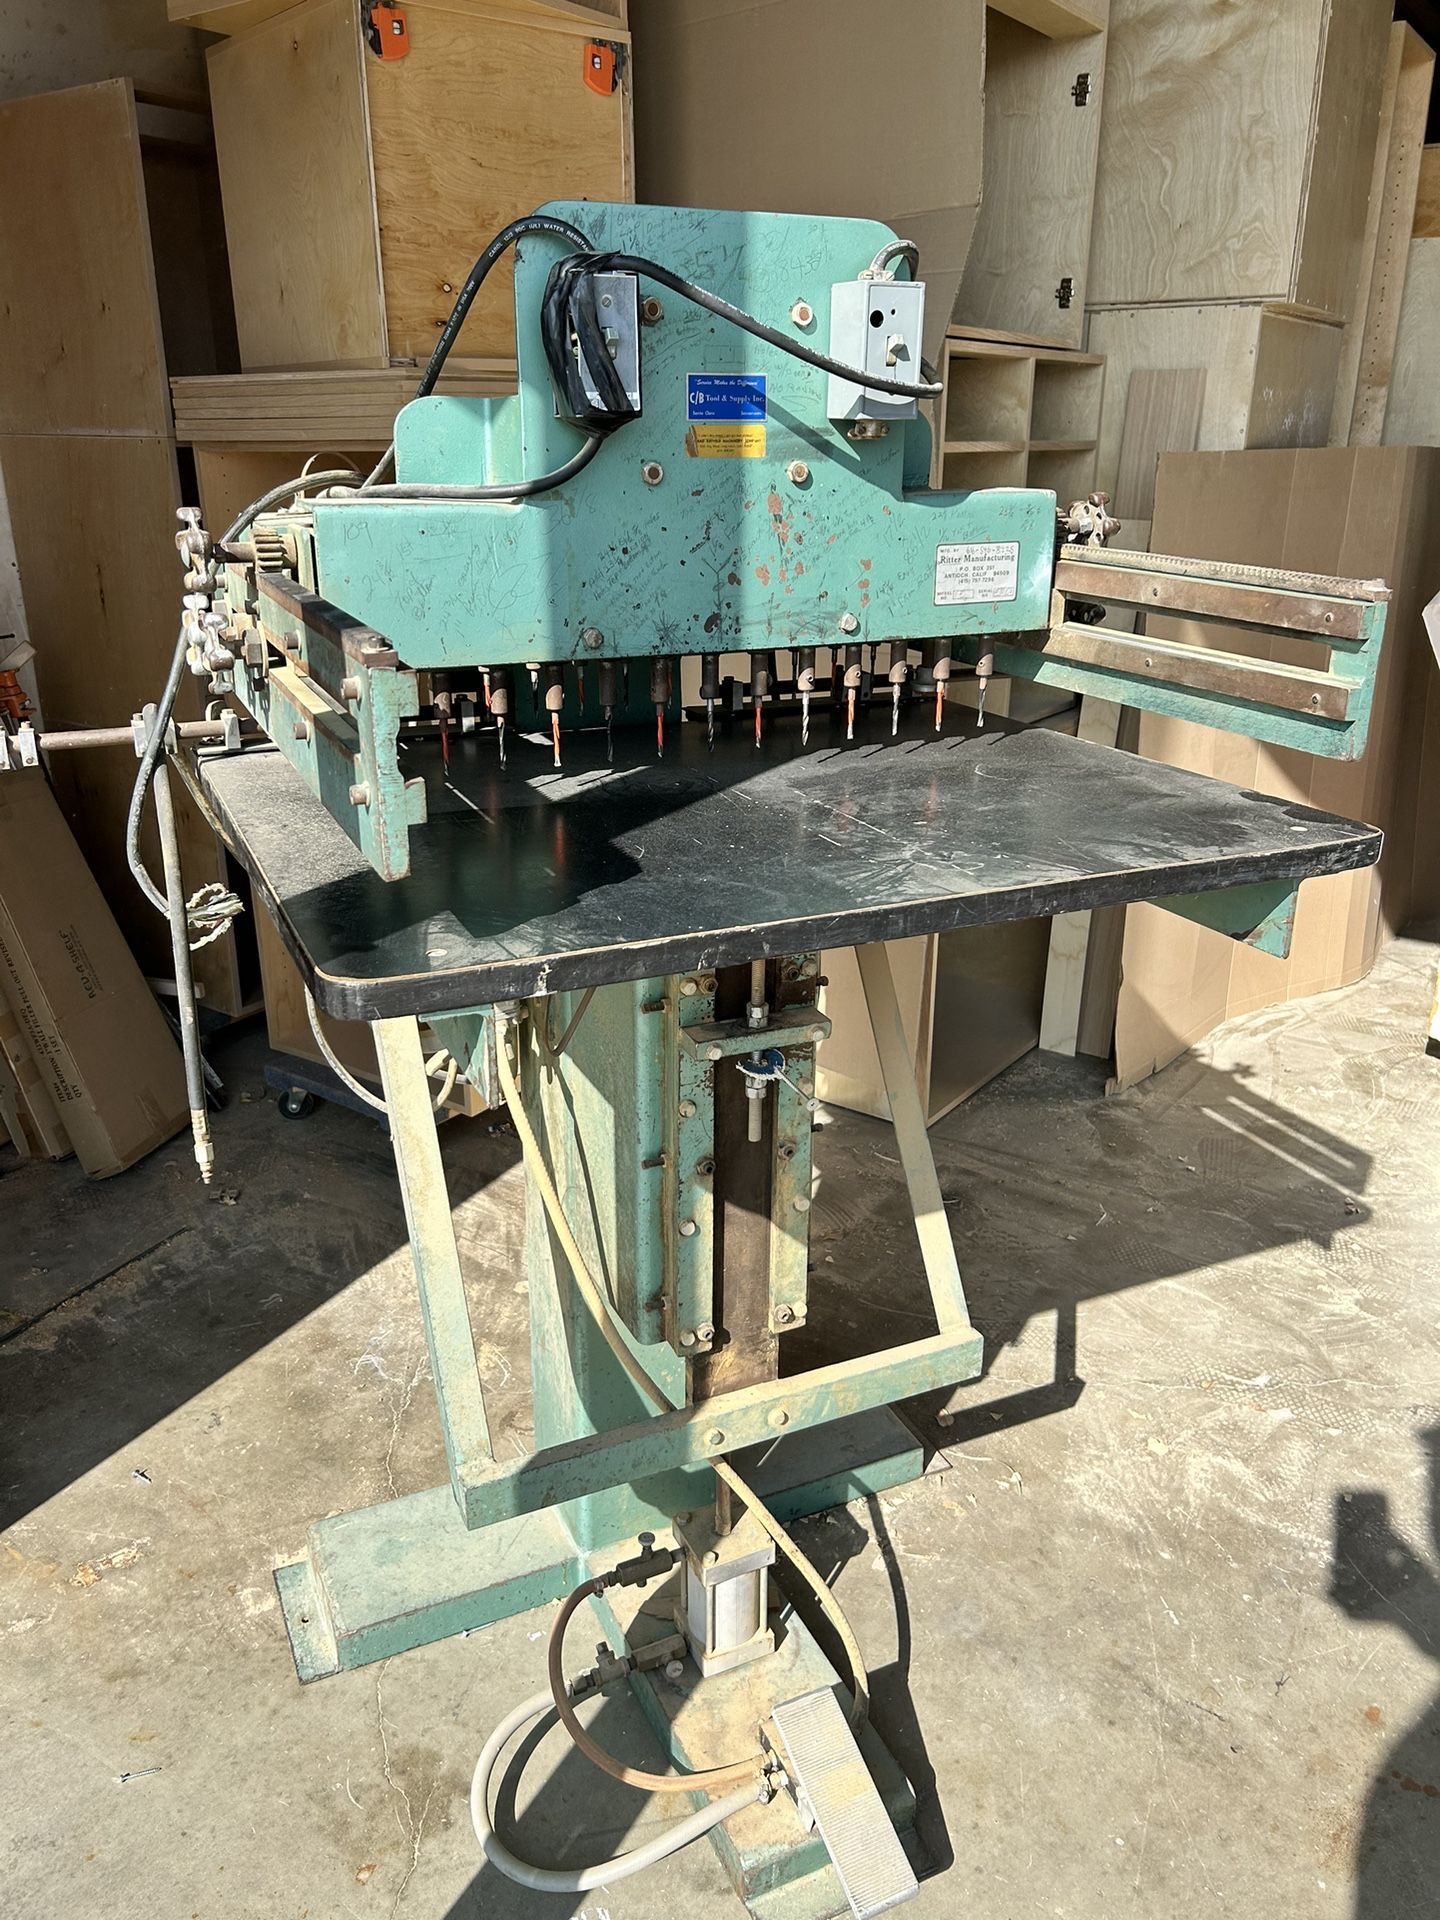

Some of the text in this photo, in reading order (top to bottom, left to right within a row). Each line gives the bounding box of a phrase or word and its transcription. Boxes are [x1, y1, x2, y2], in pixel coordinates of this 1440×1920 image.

[543, 223, 564, 233] WATER
[689, 390, 704, 405] C/B
[729, 395, 750, 404] Supply
[343, 521, 374, 548] 109
[940, 553, 1015, 564] Ritter Manufacturing
[25, 1003, 40, 1028] FILLER
[48, 1034, 58, 1048] SET
[71, 1084, 82, 1098] QTY
